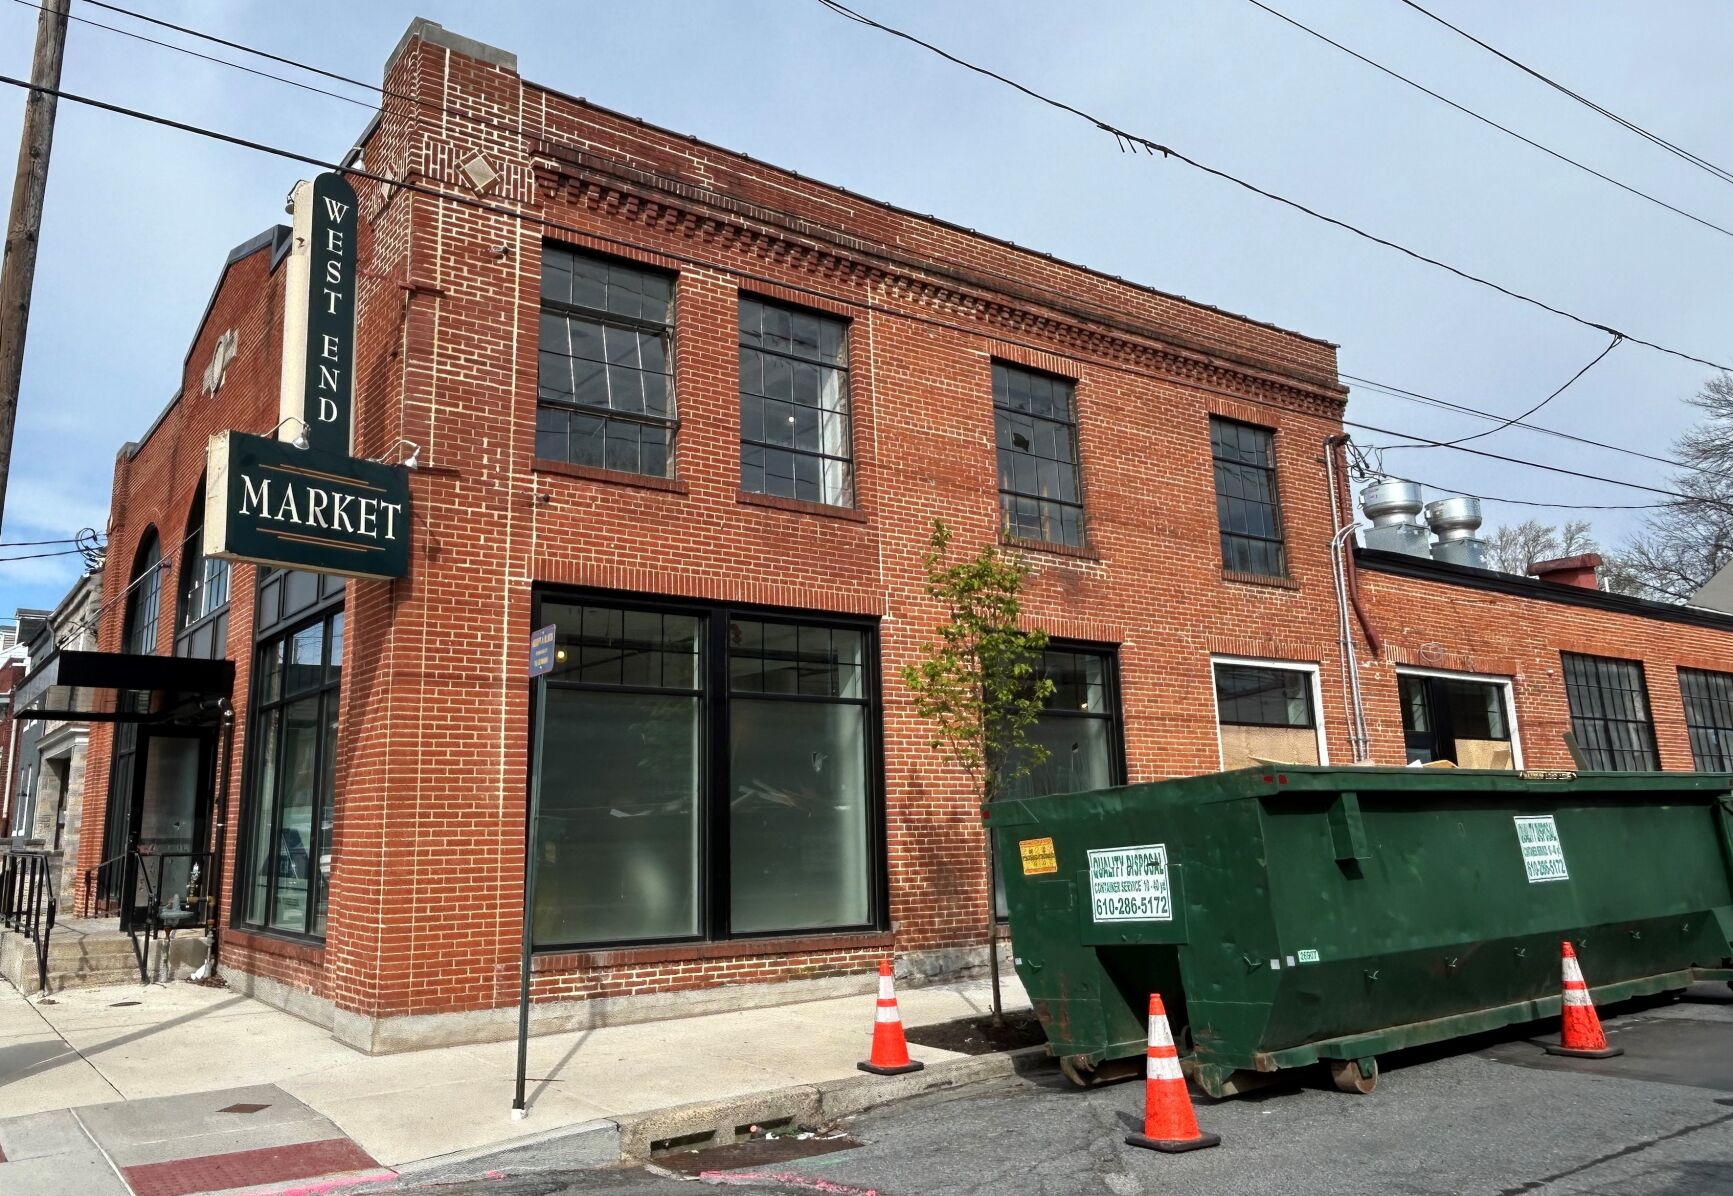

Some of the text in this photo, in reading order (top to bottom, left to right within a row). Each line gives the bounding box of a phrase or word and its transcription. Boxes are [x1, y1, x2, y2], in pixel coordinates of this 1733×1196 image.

[318, 195, 350, 423] WEST END
[239, 474, 402, 540] MARKET
[1093, 852, 1164, 879] QUALITY DISPOSAL
[1096, 895, 1168, 916] 610-286-5172
